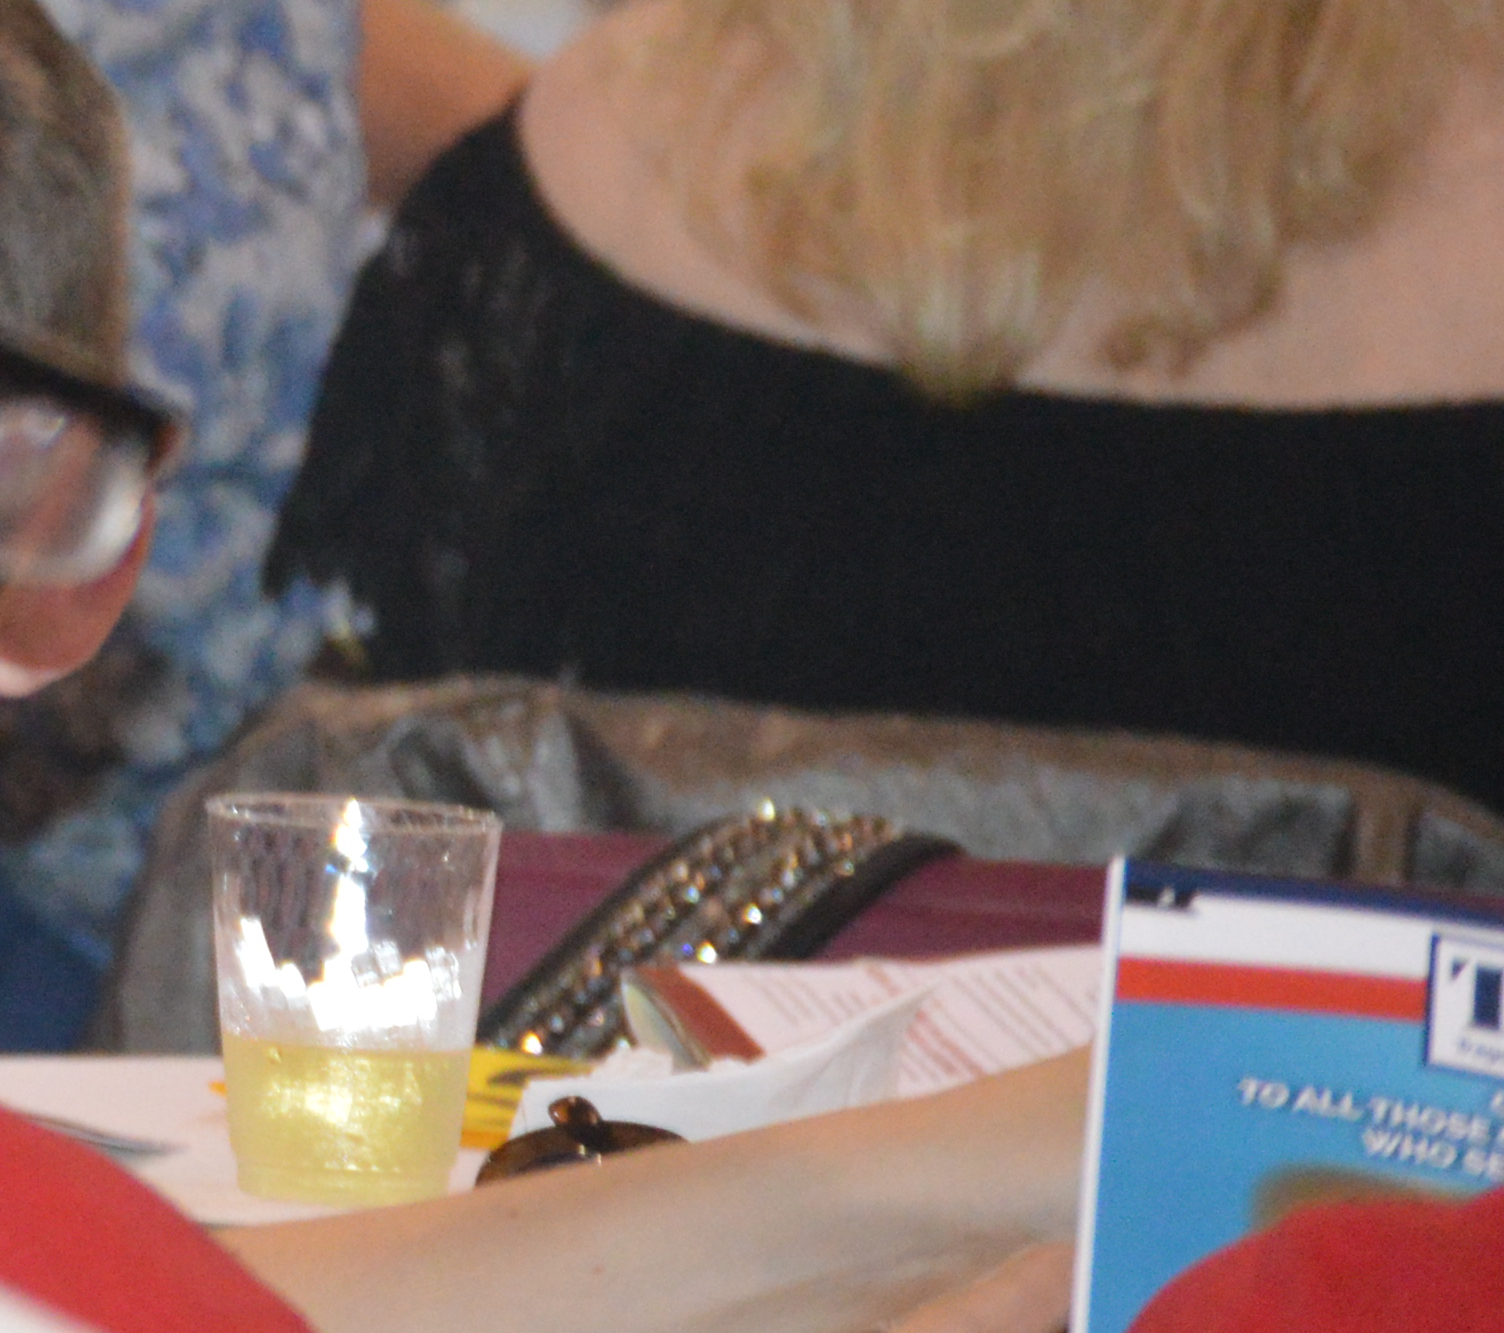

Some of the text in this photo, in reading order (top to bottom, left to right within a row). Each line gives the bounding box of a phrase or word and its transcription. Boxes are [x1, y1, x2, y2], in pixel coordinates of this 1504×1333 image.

[1238, 1077, 1290, 1110] TO
[1292, 1085, 1365, 1123] ALL
[1367, 1096, 1491, 1148] THOSE
[1362, 1128, 1458, 1171] WHO
